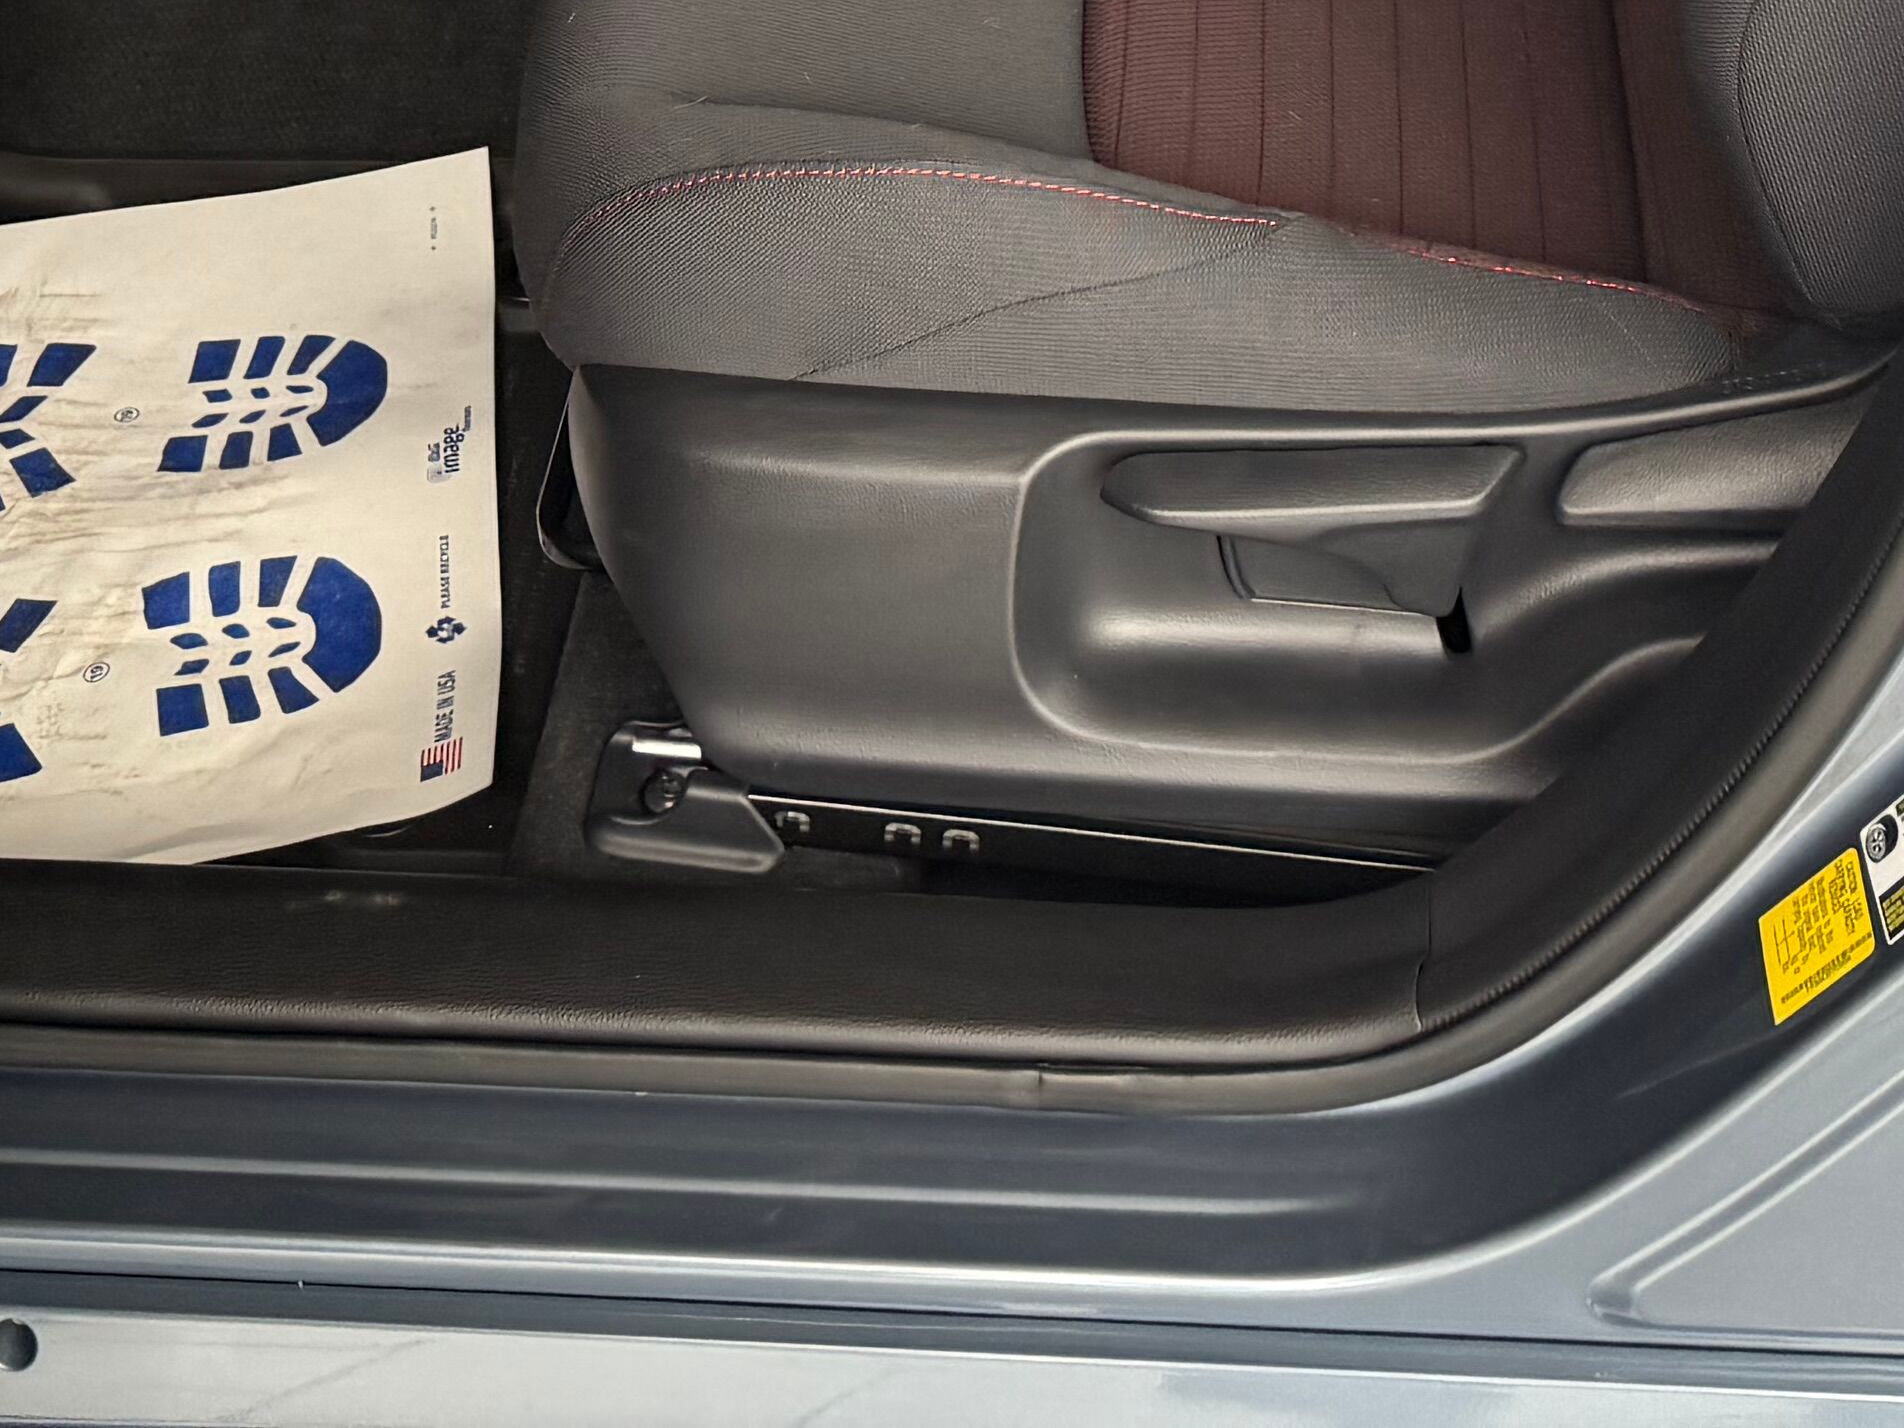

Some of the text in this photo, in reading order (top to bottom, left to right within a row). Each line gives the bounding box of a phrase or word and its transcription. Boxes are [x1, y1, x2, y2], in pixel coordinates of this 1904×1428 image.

[434, 669, 457, 743] MADE IN USA
